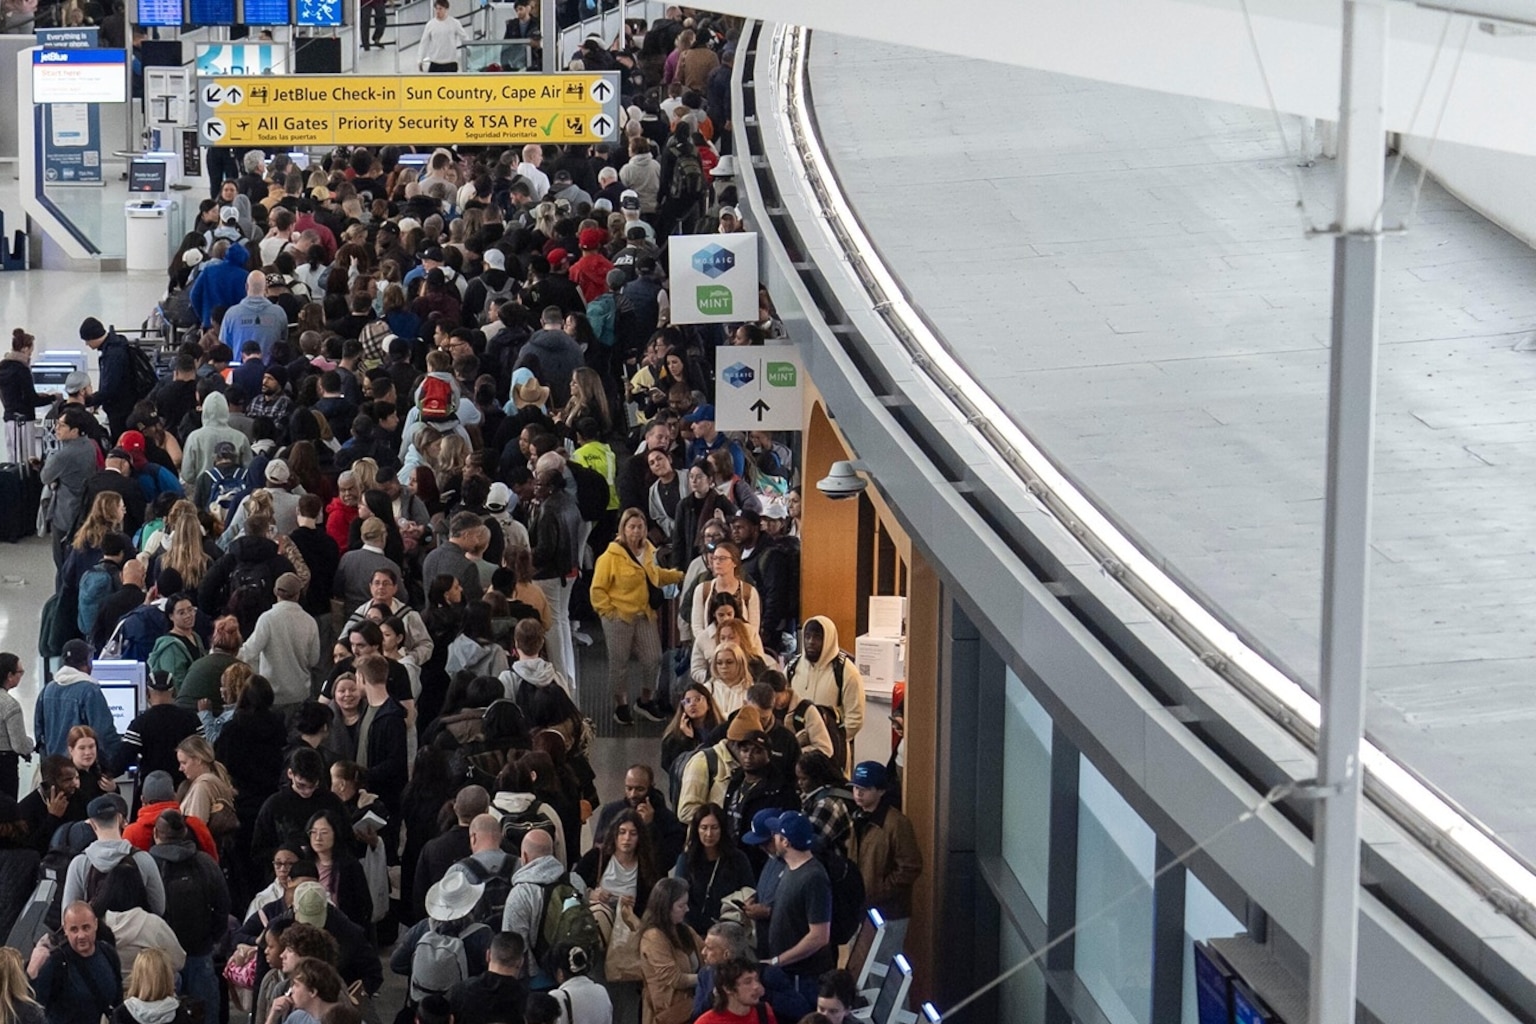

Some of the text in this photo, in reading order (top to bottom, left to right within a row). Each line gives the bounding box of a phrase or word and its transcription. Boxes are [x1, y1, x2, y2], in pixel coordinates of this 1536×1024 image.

[40, 52, 68, 63] jetBlue
[273, 86, 396, 101] JetBlue Check-in
[406, 85, 562, 103] Sun Country, Cape Air
[257, 117, 328, 130] All Gates
[338, 115, 537, 132] Priority Security & TSA Pre
[290, 133, 317, 142] puertas
[465, 131, 501, 139] Seguridad
[694, 256, 732, 265] MOSAIC
[699, 298, 729, 309] MINT
[769, 372, 794, 381] MINT
